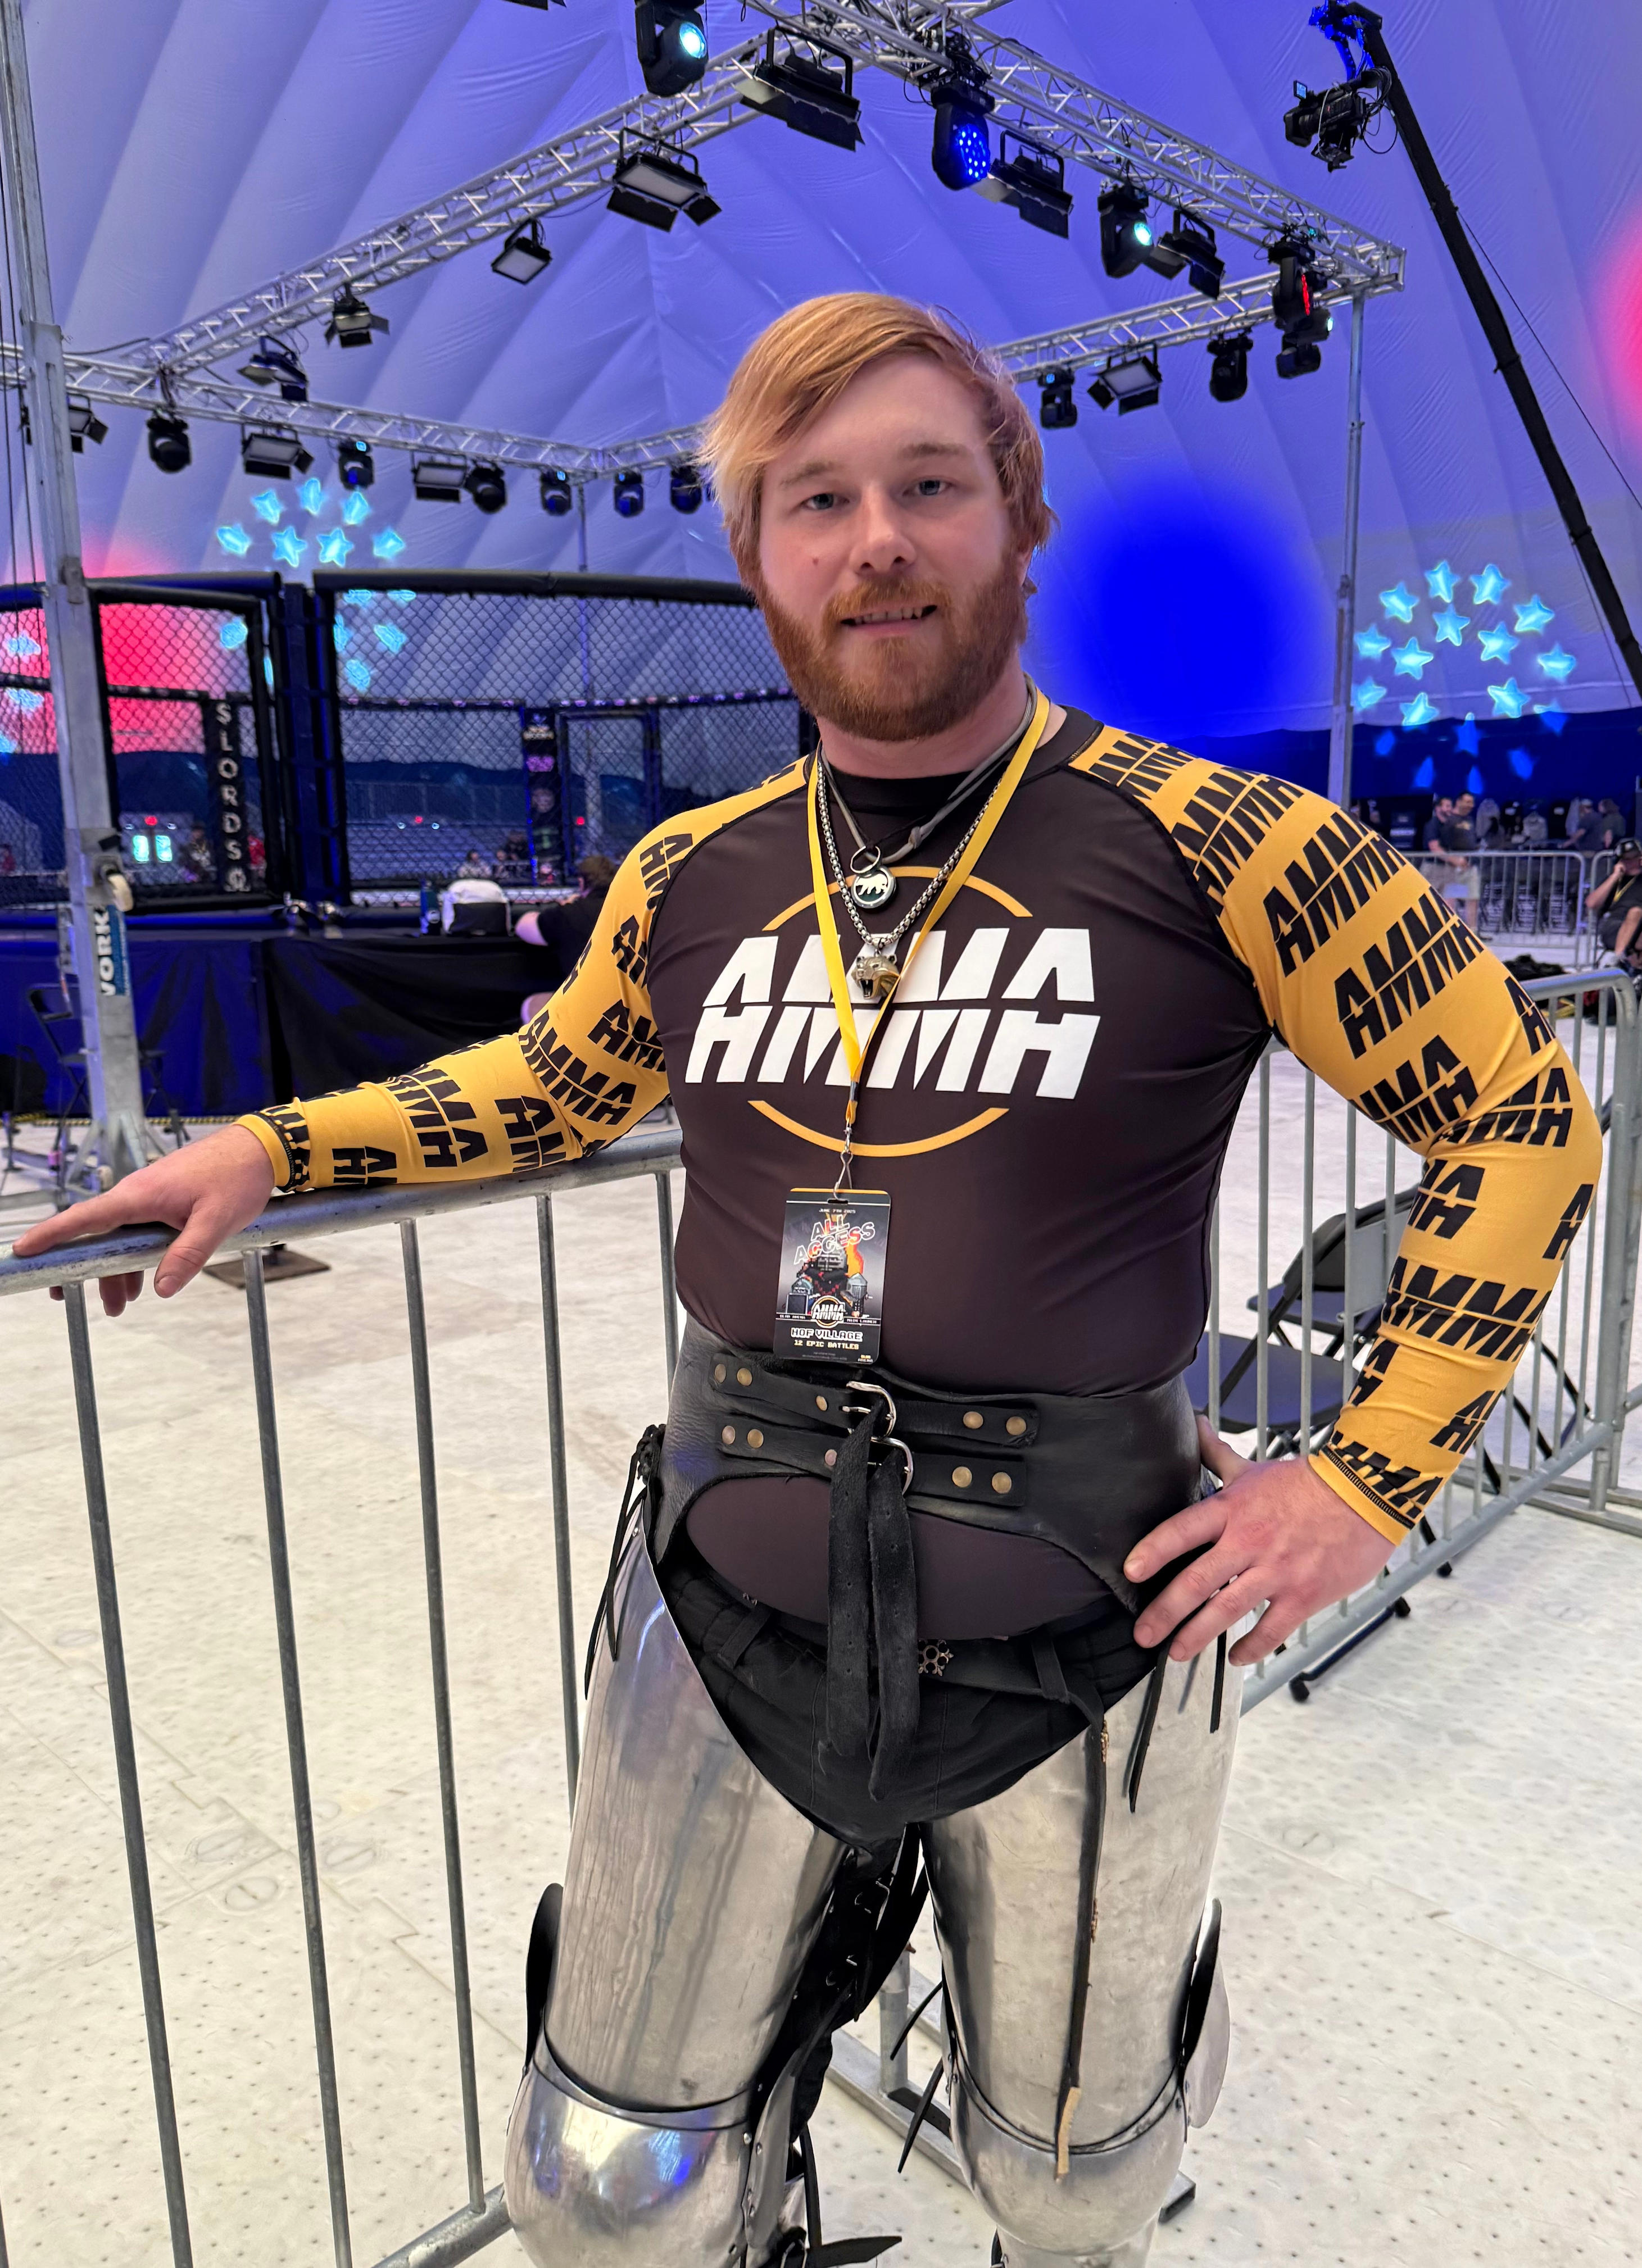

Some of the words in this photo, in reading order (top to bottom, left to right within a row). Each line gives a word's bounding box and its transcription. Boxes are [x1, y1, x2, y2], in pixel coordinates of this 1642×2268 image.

[685, 928, 1100, 1099] AMMA
[518, 1009, 637, 1125] AMMA
[793, 1221, 876, 1265] ACCESS
[810, 1214, 850, 1242] ALL
[791, 1327, 814, 1338] HOF
[815, 1329, 863, 1342] VILLAGE
